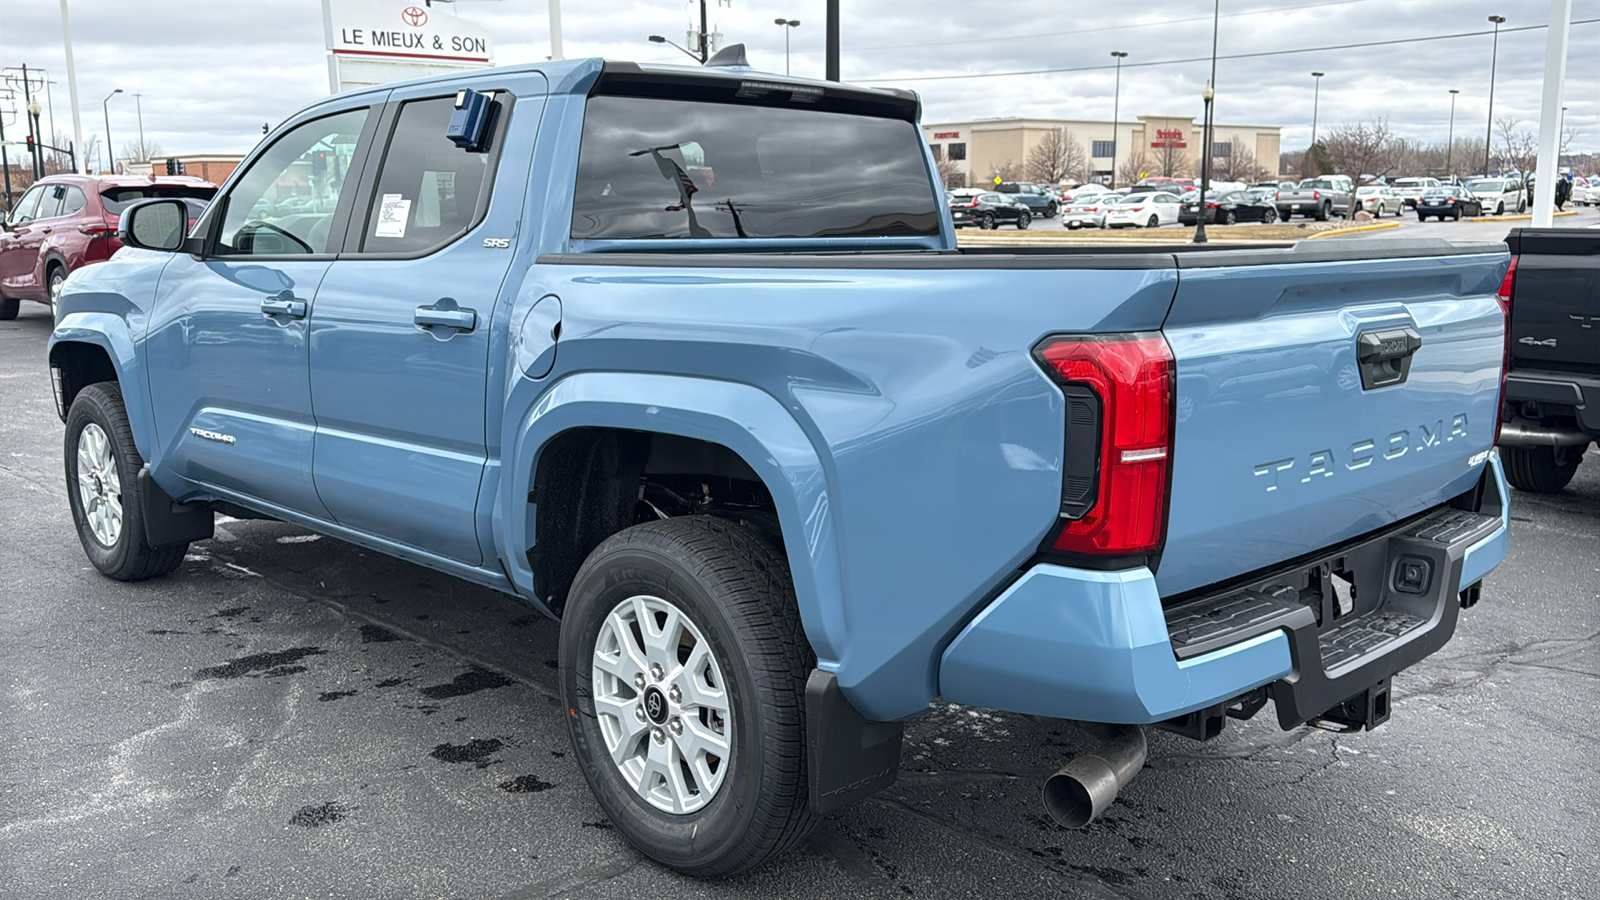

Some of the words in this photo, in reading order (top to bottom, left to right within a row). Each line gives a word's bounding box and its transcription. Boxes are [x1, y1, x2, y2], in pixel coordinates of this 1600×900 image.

[342, 28, 364, 45] LE
[371, 30, 425, 49] MIEUX
[432, 35, 443, 50] &
[451, 36, 486, 53] SON
[1380, 338, 1407, 353] TOYOTA
[189, 427, 236, 444] TACOMA
[1253, 412, 1469, 493] TACOMA
